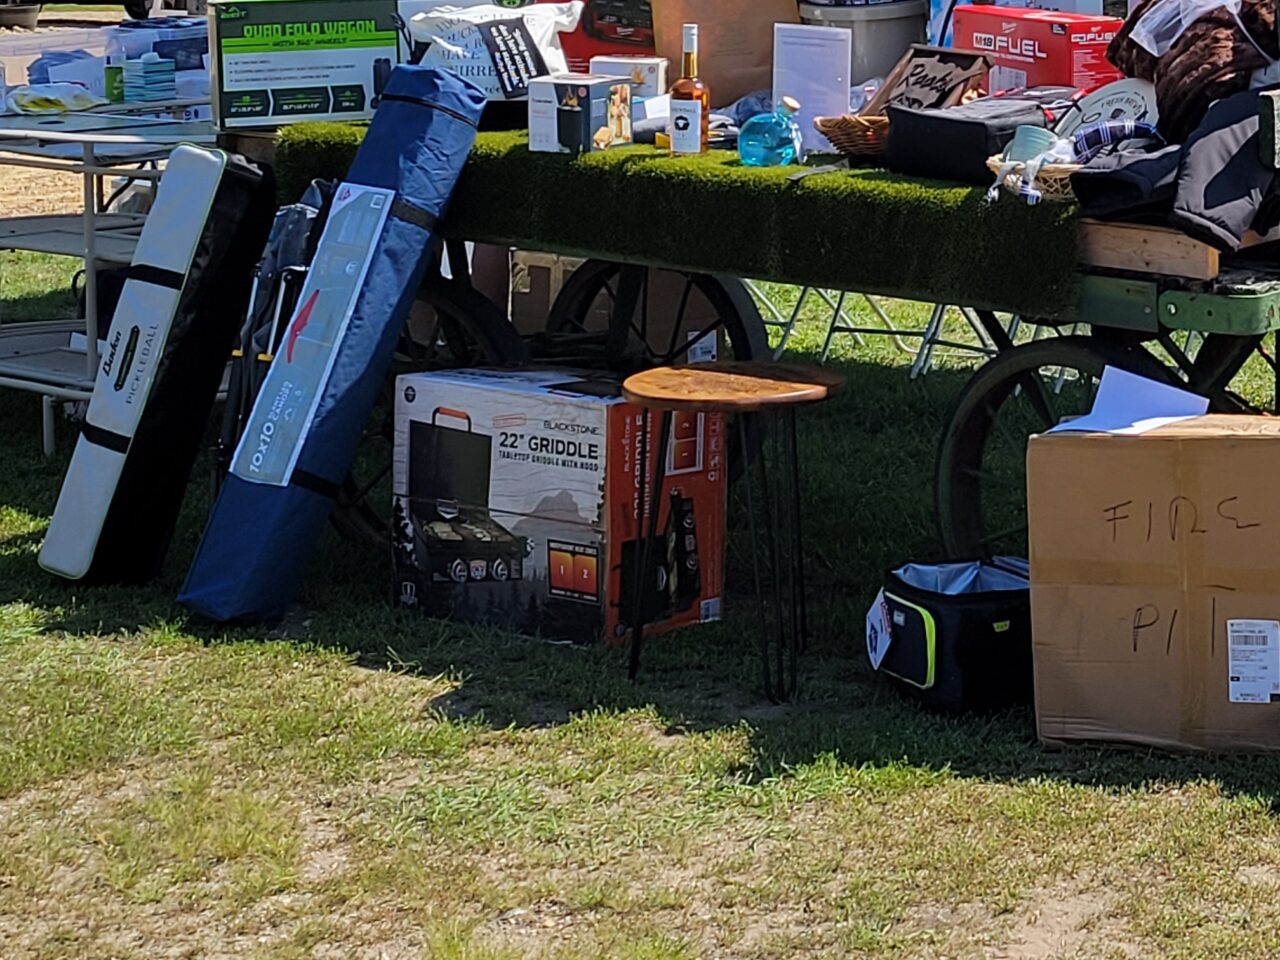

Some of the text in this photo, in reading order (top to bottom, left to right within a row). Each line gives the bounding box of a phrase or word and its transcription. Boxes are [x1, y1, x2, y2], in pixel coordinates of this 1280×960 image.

[243, 20, 375, 38] QUAD FOLD WAGON
[974, 34, 993, 48] M18
[995, 36, 1047, 58] FUEL
[125, 323, 159, 405] PICKLEBALL
[543, 420, 600, 435] BLACKSTONE
[250, 422, 274, 472] 10x10
[499, 432, 599, 460] 22" GRIDDLE
[499, 450, 530, 462] TABLETOP
[532, 455, 559, 466] GRIDDLE
[561, 460, 578, 469] WITH
[1102, 495, 1262, 542] FIRE
[1131, 584, 1236, 657] PIT
